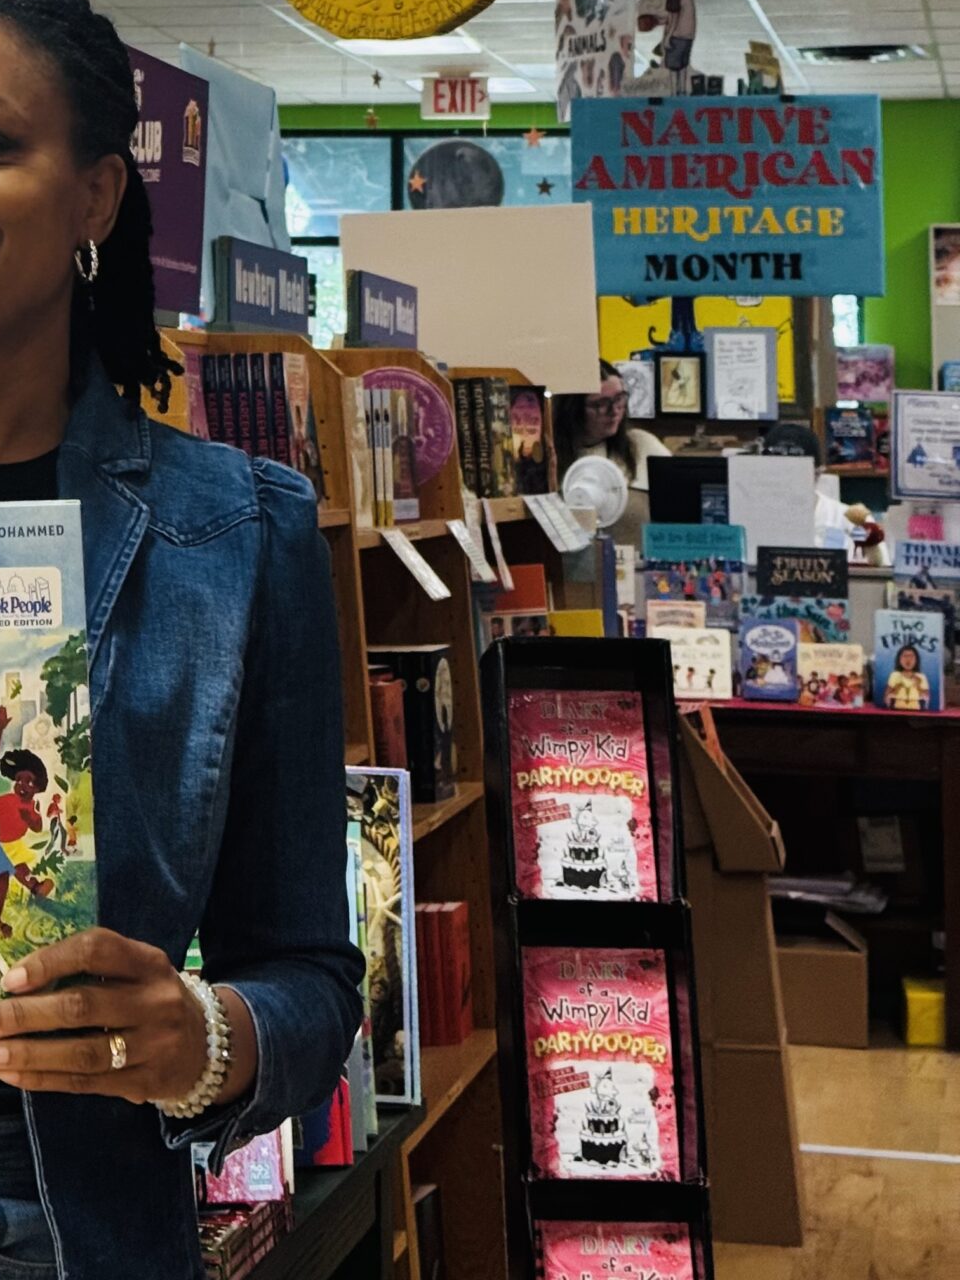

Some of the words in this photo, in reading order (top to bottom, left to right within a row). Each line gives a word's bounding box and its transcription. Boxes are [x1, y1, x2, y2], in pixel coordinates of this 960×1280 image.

[433, 79, 478, 113] EXIT
[621, 105, 833, 147] NATIVE
[575, 147, 876, 200] AMERICAN
[611, 206, 845, 242] HERITAGE
[644, 252, 803, 282] MONTH
[13, 618, 53, 627] EDITION
[892, 620, 924, 633] TWO
[542, 694, 609, 719] DIARY
[523, 735, 591, 763] Wimpy
[595, 732, 628, 761] Kid
[559, 952, 628, 981] DIARY
[579, 981, 593, 998] of
[600, 989, 609, 998] a
[540, 996, 611, 1028] Wimpy
[616, 995, 651, 1025] Kid
[580, 1225, 653, 1255] DIARY
[601, 1256, 617, 1272] of
[624, 1265, 632, 1273] a
